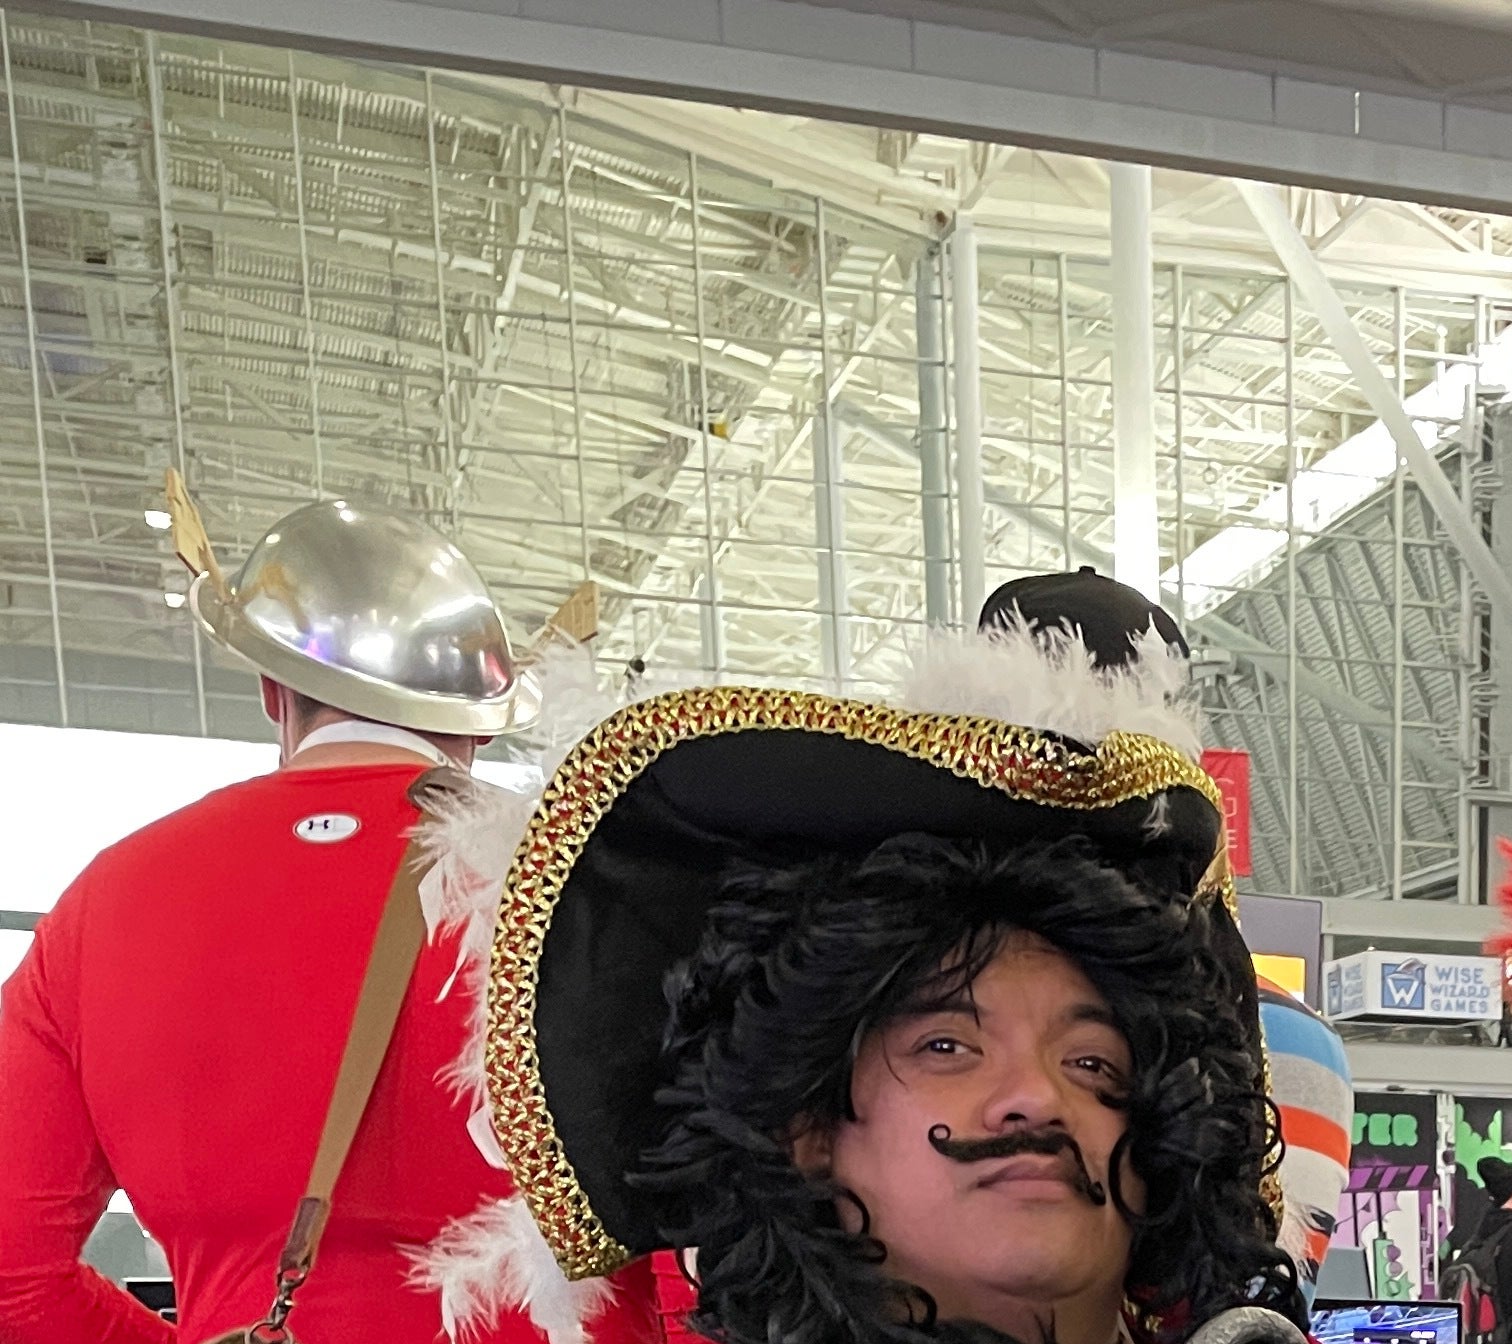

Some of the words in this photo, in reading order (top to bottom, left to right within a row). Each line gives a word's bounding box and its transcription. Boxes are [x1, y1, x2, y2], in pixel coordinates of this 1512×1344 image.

[1435, 966, 1484, 984] WISE
[1430, 984, 1490, 998] WIZARD
[1431, 998, 1489, 1014] GAMES
